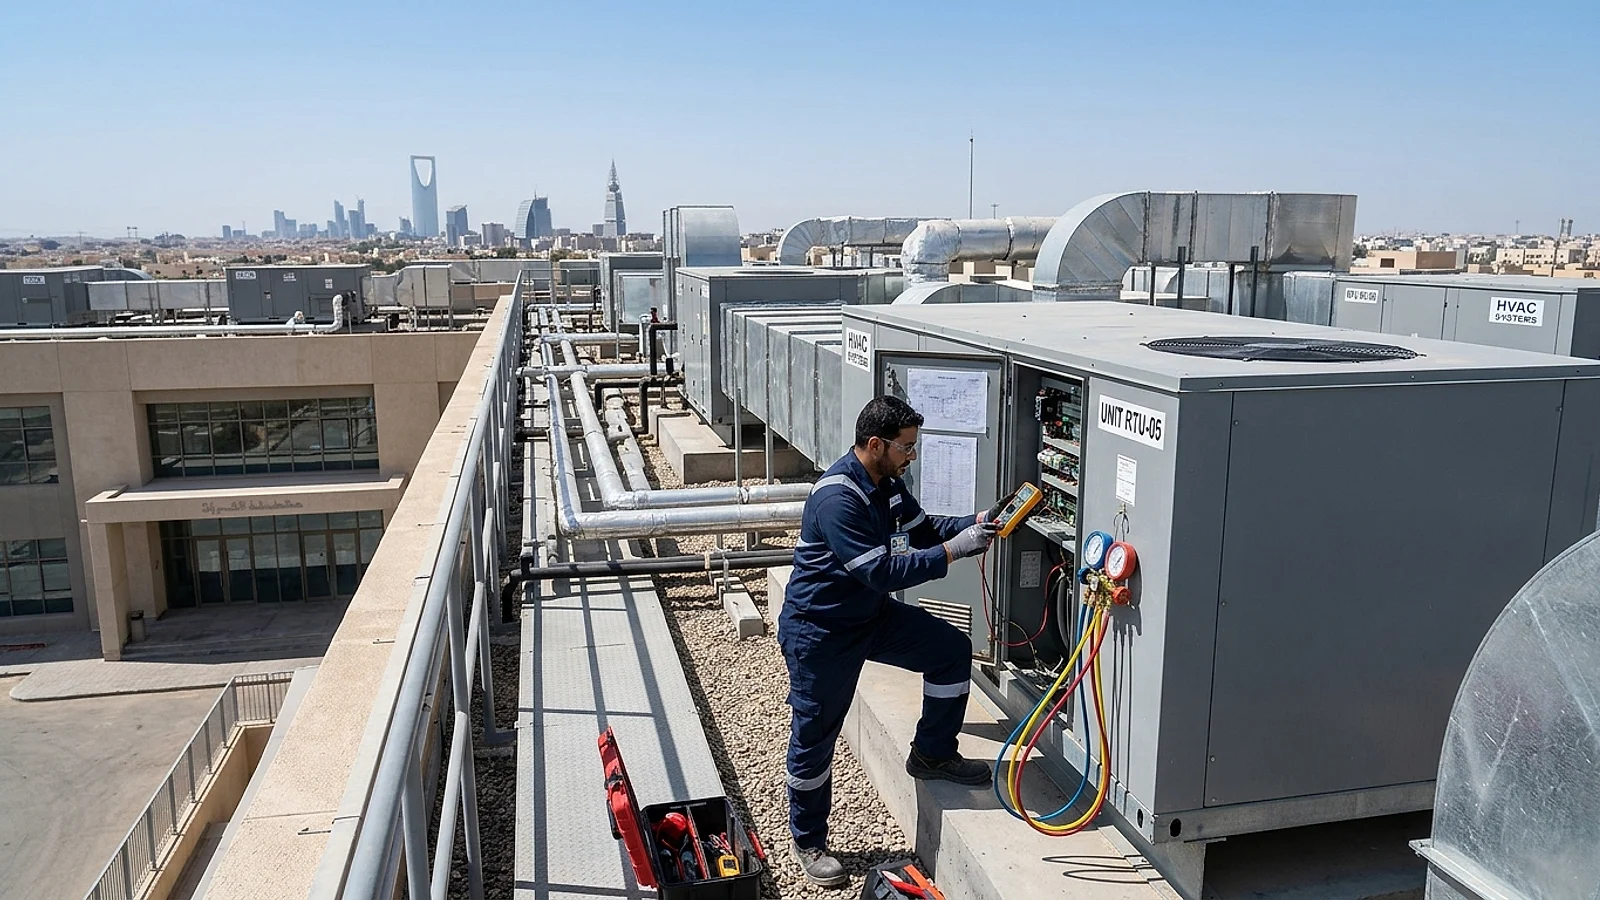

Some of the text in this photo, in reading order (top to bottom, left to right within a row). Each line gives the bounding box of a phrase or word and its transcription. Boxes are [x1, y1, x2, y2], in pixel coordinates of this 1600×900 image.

[1497, 300, 1537, 314] HVAC
[848, 331, 868, 353] HVAC
[1101, 402, 1162, 441] UNIT RTU-05
